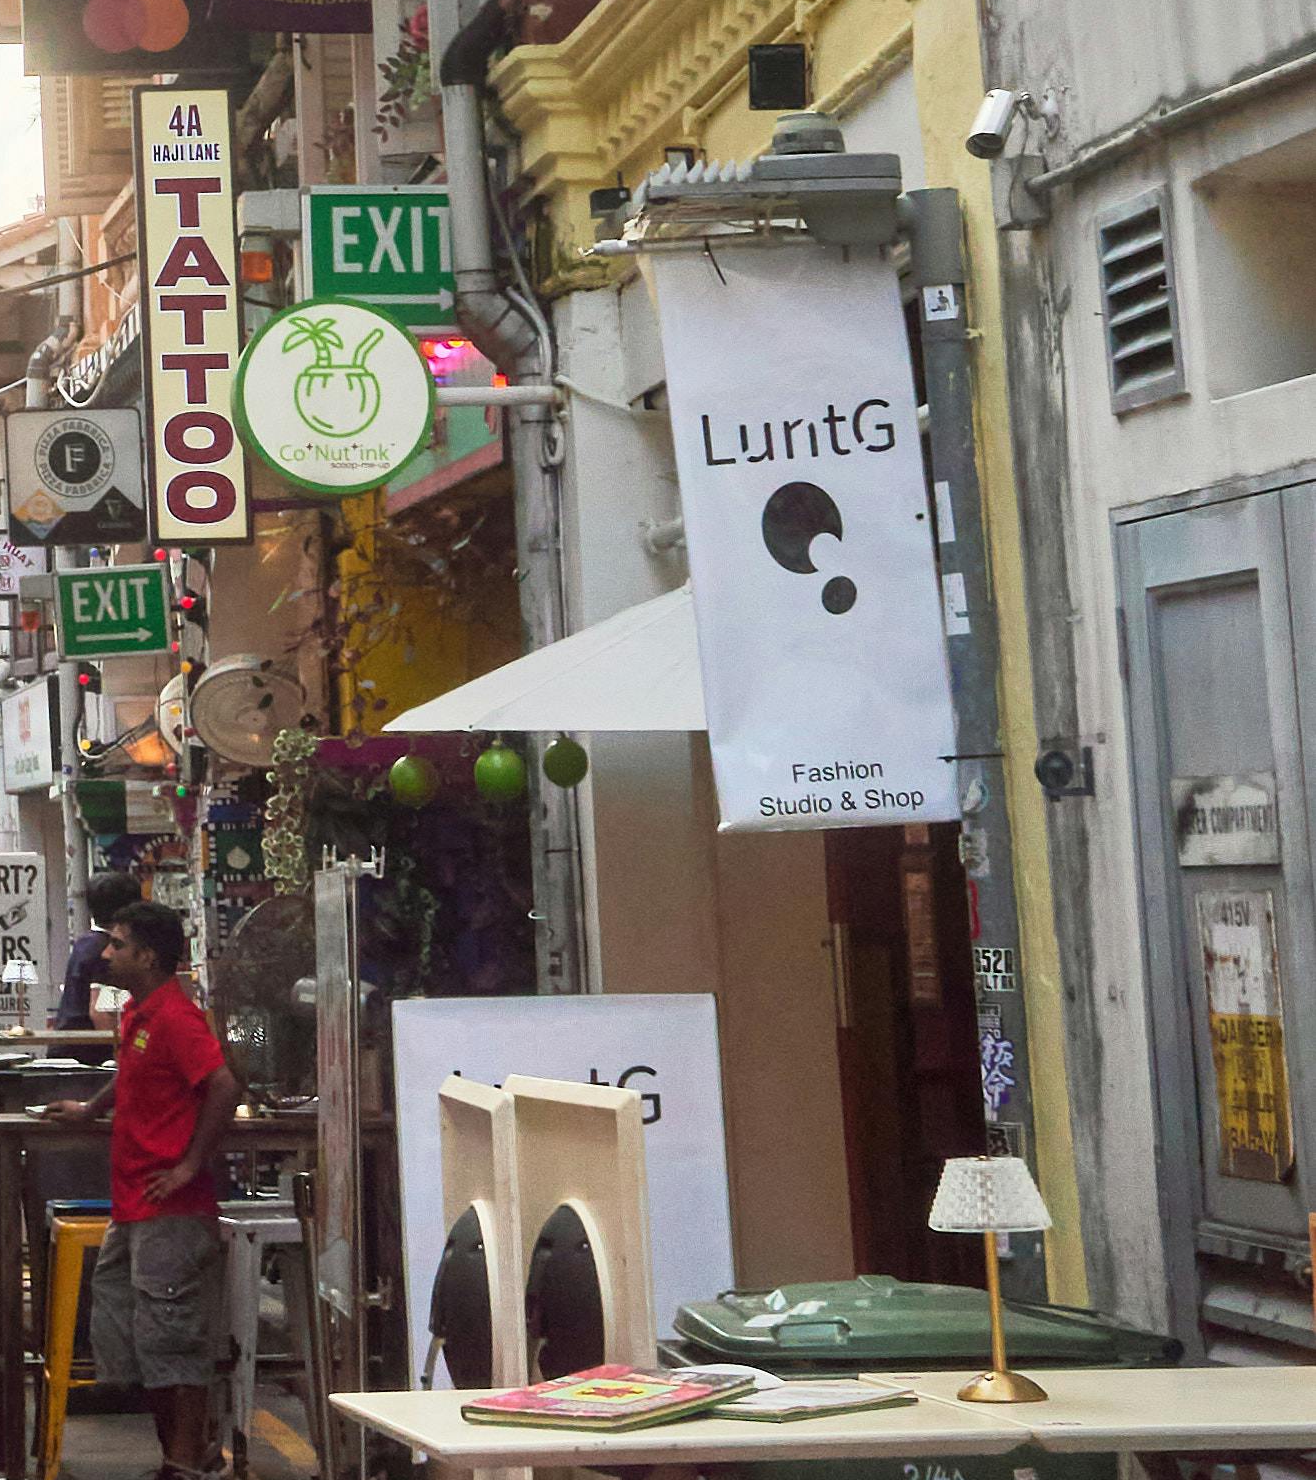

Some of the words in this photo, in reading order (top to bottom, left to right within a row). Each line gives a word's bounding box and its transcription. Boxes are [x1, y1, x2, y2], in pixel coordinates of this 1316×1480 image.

[169, 105, 203, 137] 4A
[153, 144, 186, 162] HAJI
[188, 144, 221, 161] LANE
[331, 205, 452, 274] EXIT
[154, 178, 237, 525] TATTOO
[700, 398, 897, 466] LuntG
[2, 541, 36, 569] HUAT
[71, 577, 150, 622] EXIT
[791, 761, 884, 784] Fashion
[759, 795, 833, 818] Studio
[840, 792, 858, 811] &
[863, 788, 925, 813] Shop
